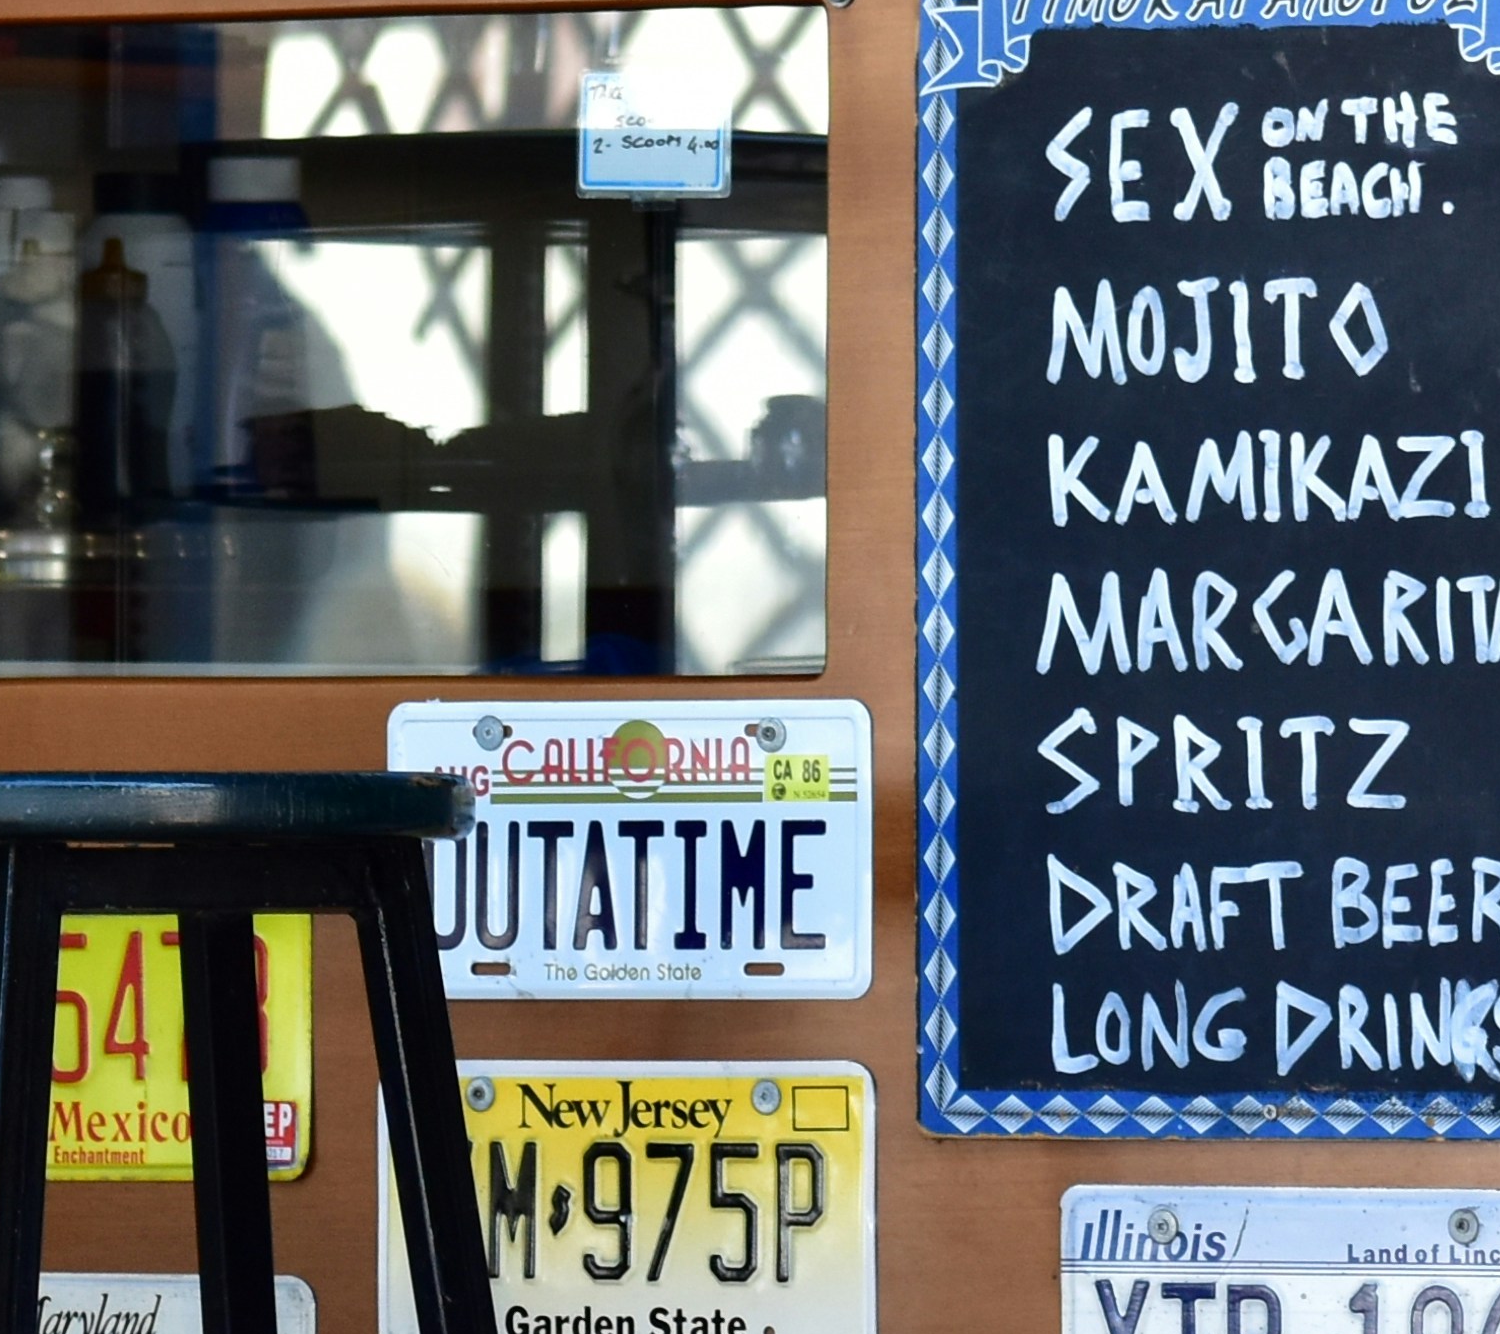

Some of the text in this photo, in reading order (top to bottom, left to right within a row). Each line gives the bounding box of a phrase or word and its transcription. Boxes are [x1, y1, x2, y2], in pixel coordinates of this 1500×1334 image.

[1260, 92, 1459, 148] ON THE
[1044, 101, 1240, 223] SEX
[1045, 277, 1390, 385] MOJITO
[1047, 429, 1492, 527] KAMIKAZI
[501, 736, 752, 786] CALIFORNIA
[772, 757, 822, 784] CA 86
[1036, 707, 1410, 814] SPRITZ
[1046, 852, 1304, 955] DRAFT
[544, 963, 703, 982] The Golden State
[1051, 980, 1249, 1075] LONG
[48, 1101, 192, 1143] Mexico
[263, 1102, 294, 1139] EP
[517, 1080, 733, 1138] New Jersey
[53, 1145, 146, 1165] Enchantment
[1079, 1208, 1228, 1262] Illinois
[1346, 1243, 1413, 1265] Land
[1414, 1243, 1440, 1265] of
